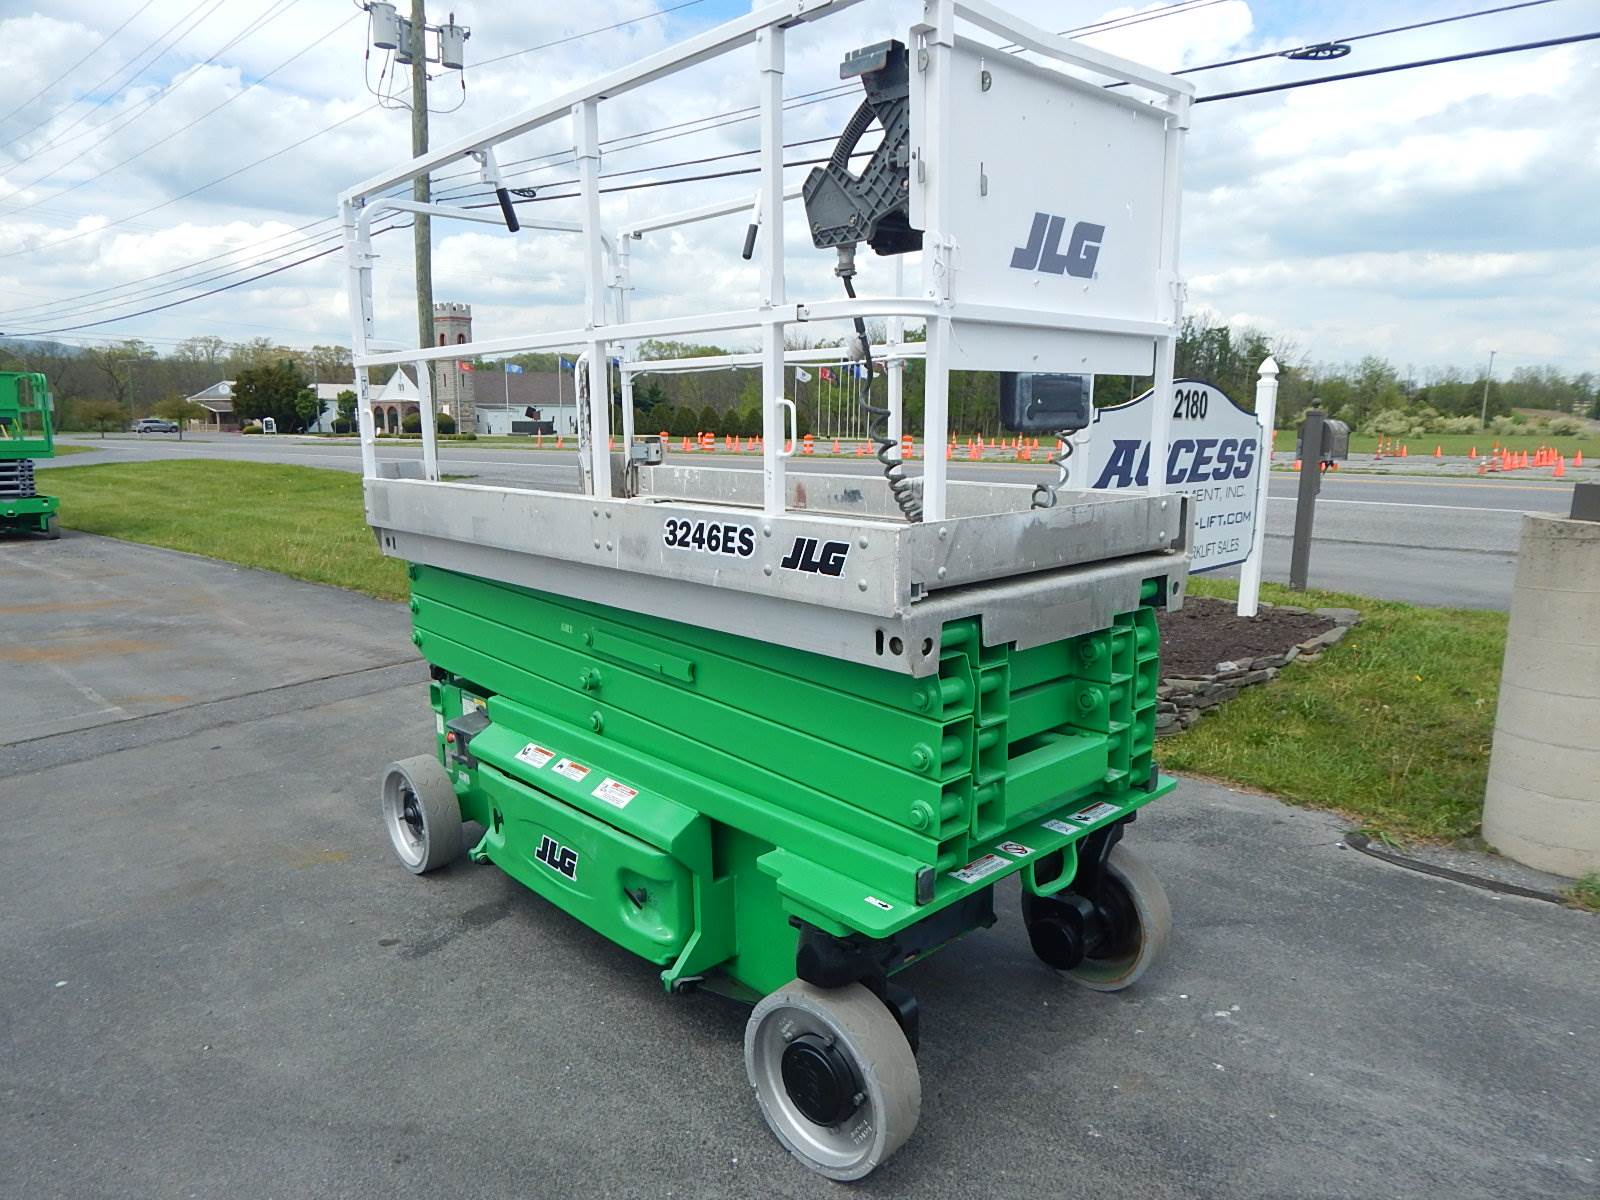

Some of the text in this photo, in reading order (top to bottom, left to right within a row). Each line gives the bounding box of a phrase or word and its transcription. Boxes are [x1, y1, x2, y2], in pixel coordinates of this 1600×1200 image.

[1010, 211, 1105, 279] JLG
[1173, 389, 1208, 419] 2180
[663, 519, 755, 557] 3246ES
[1194, 511, 1251, 529] -LIFT.COM
[781, 537, 850, 577] JLG
[1217, 538, 1239, 554] SALES
[535, 835, 579, 880] JLG
